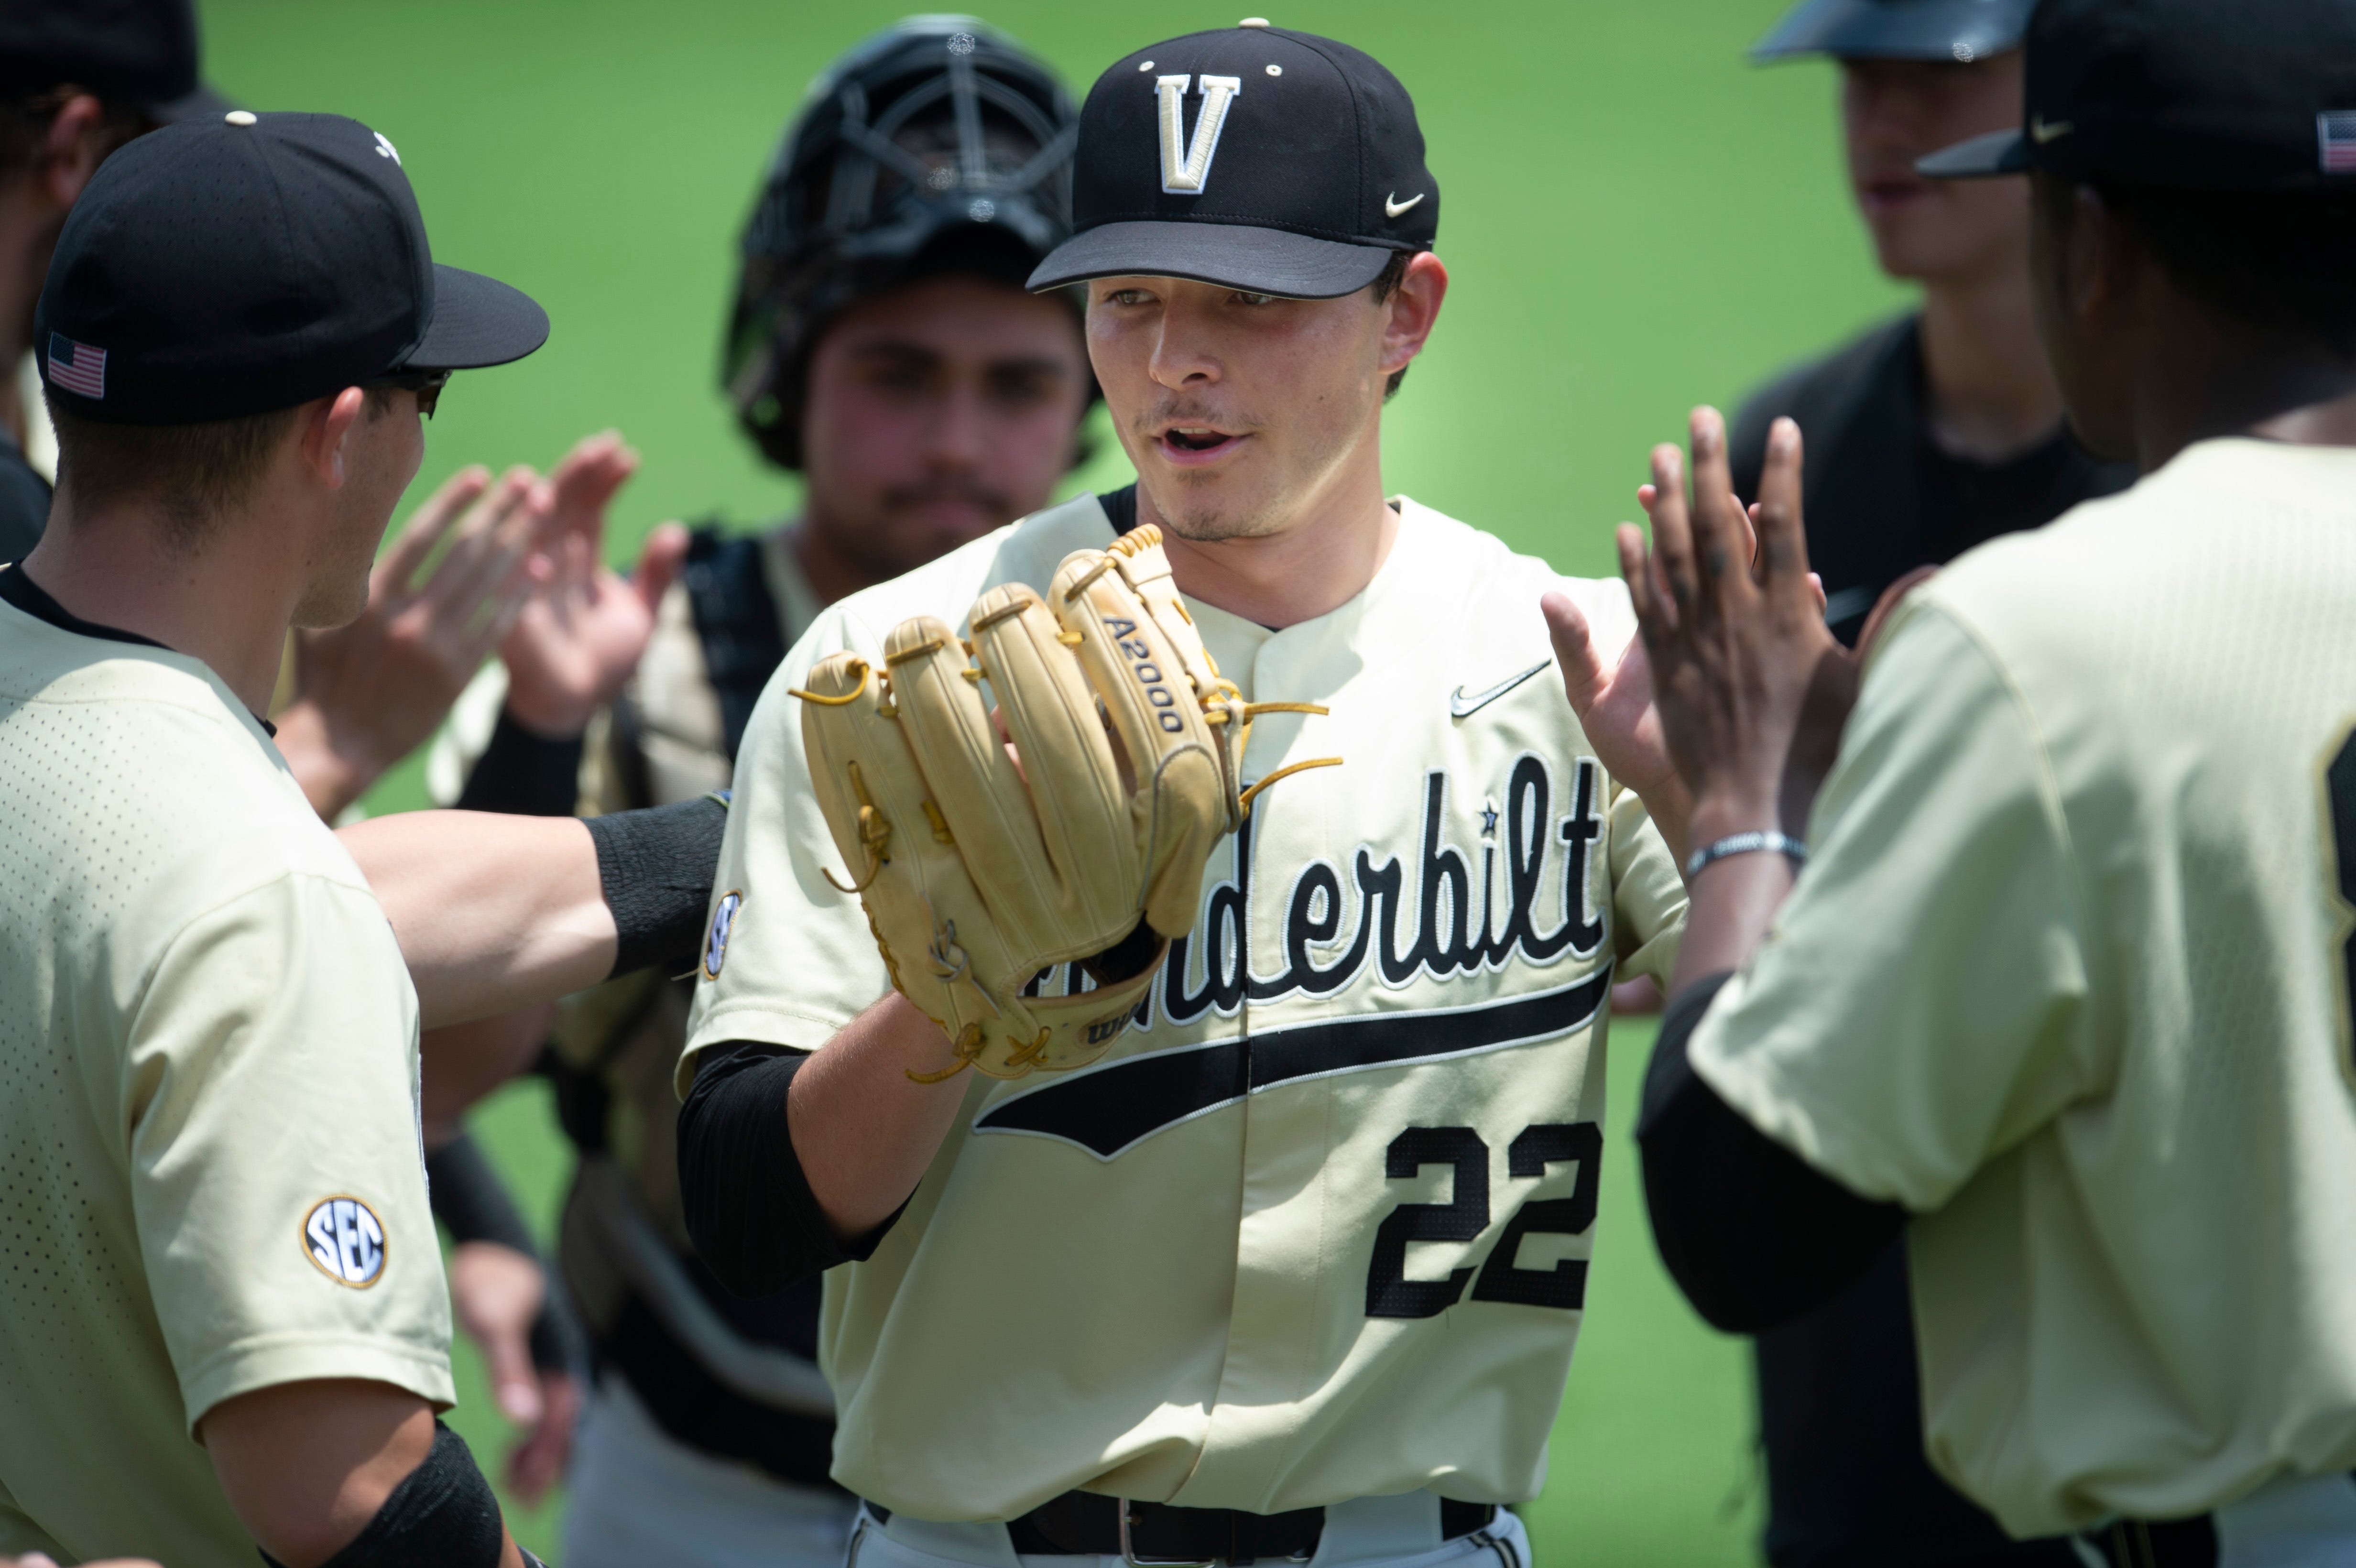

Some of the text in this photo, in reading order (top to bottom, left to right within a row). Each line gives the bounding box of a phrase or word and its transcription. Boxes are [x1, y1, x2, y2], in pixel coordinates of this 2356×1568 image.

[1154, 74, 1241, 195] V
[1102, 617, 1184, 732] A2000
[1018, 751, 1607, 1032] derbilt
[306, 1199, 384, 1283] SEC
[1365, 1122, 1603, 1318] 22
